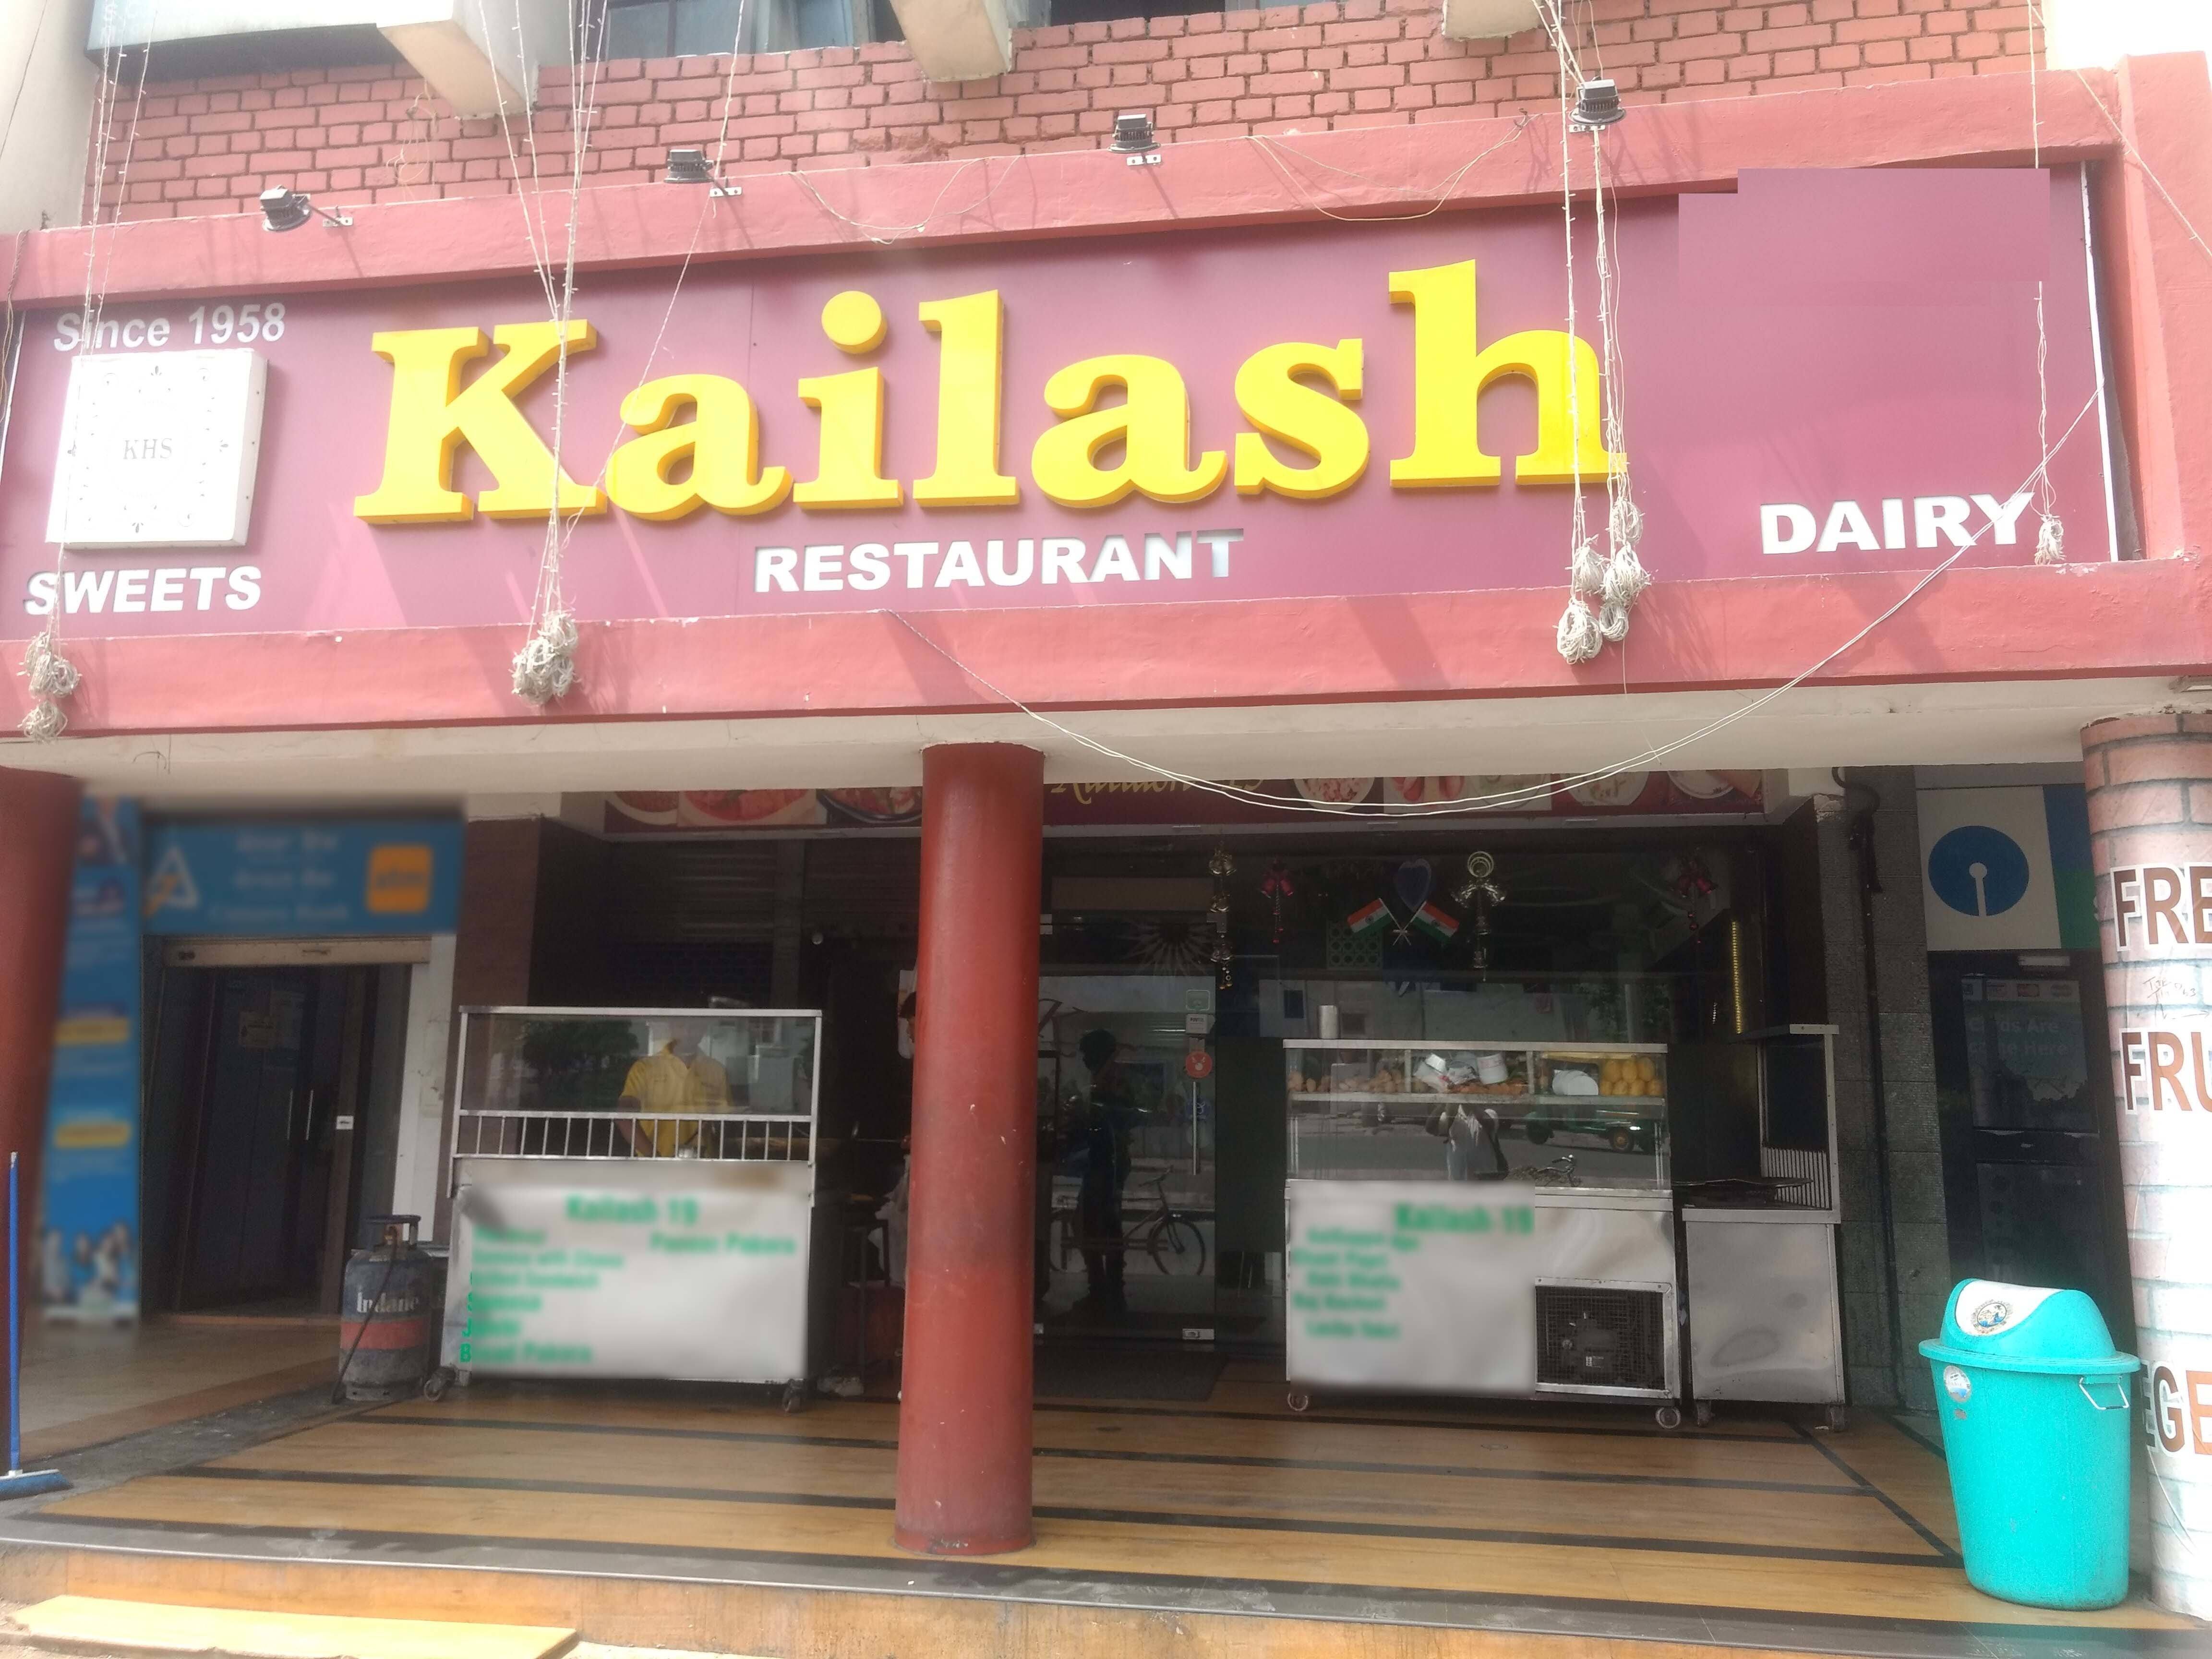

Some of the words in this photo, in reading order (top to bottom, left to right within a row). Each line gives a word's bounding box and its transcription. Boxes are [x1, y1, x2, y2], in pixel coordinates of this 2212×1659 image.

[53, 312, 170, 352] Since
[188, 302, 286, 345] 1958
[354, 259, 1628, 525] Kailash
[123, 437, 173, 460] KHS
[1760, 492, 2035, 554] DAIRY
[755, 528, 1244, 592] RESTAURANT
[23, 566, 262, 615] SWEETS
